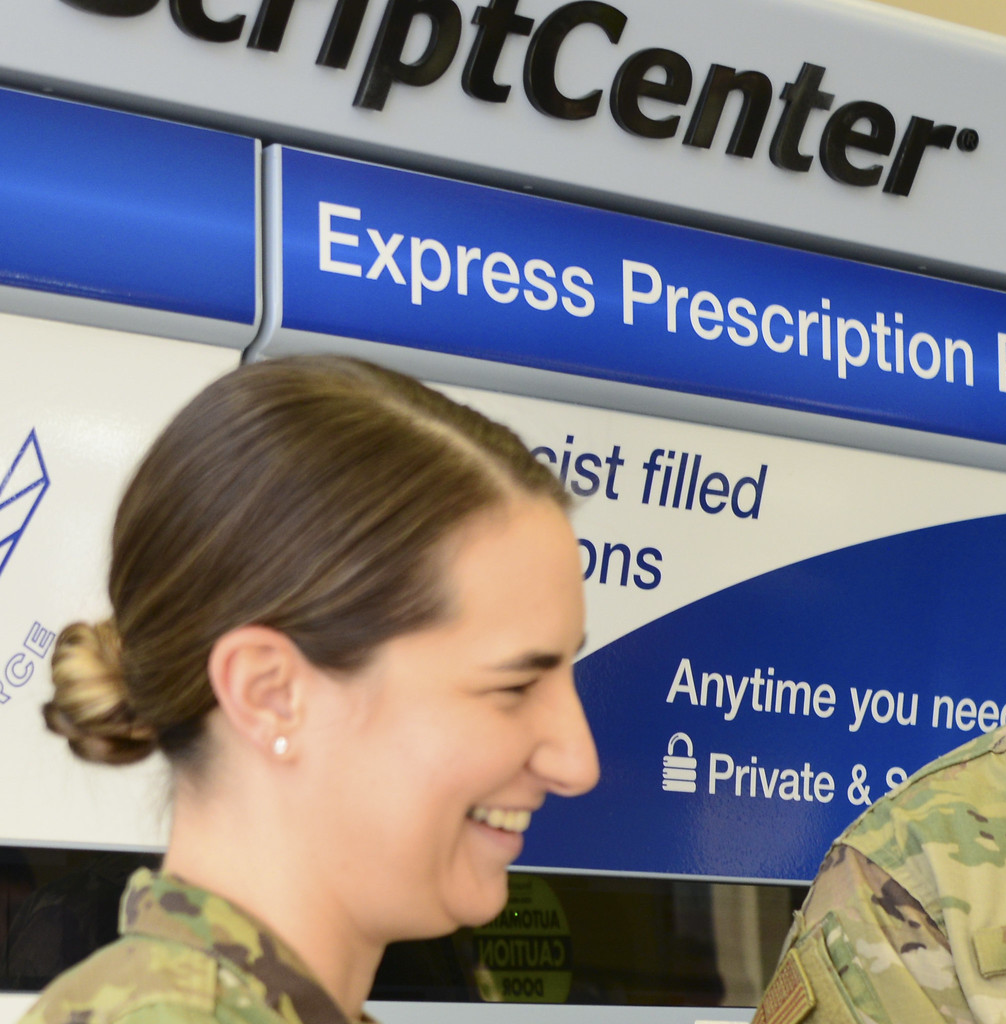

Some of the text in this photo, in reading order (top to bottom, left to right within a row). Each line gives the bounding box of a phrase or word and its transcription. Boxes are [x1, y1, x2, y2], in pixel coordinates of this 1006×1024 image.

[318, 201, 595, 317] Express
[621, 260, 974, 387] Prescription
[641, 448, 769, 520] filled
[666, 658, 836, 721] Anytime
[849, 687, 918, 732] you
[708, 752, 835, 803] Private
[847, 763, 873, 806] &
